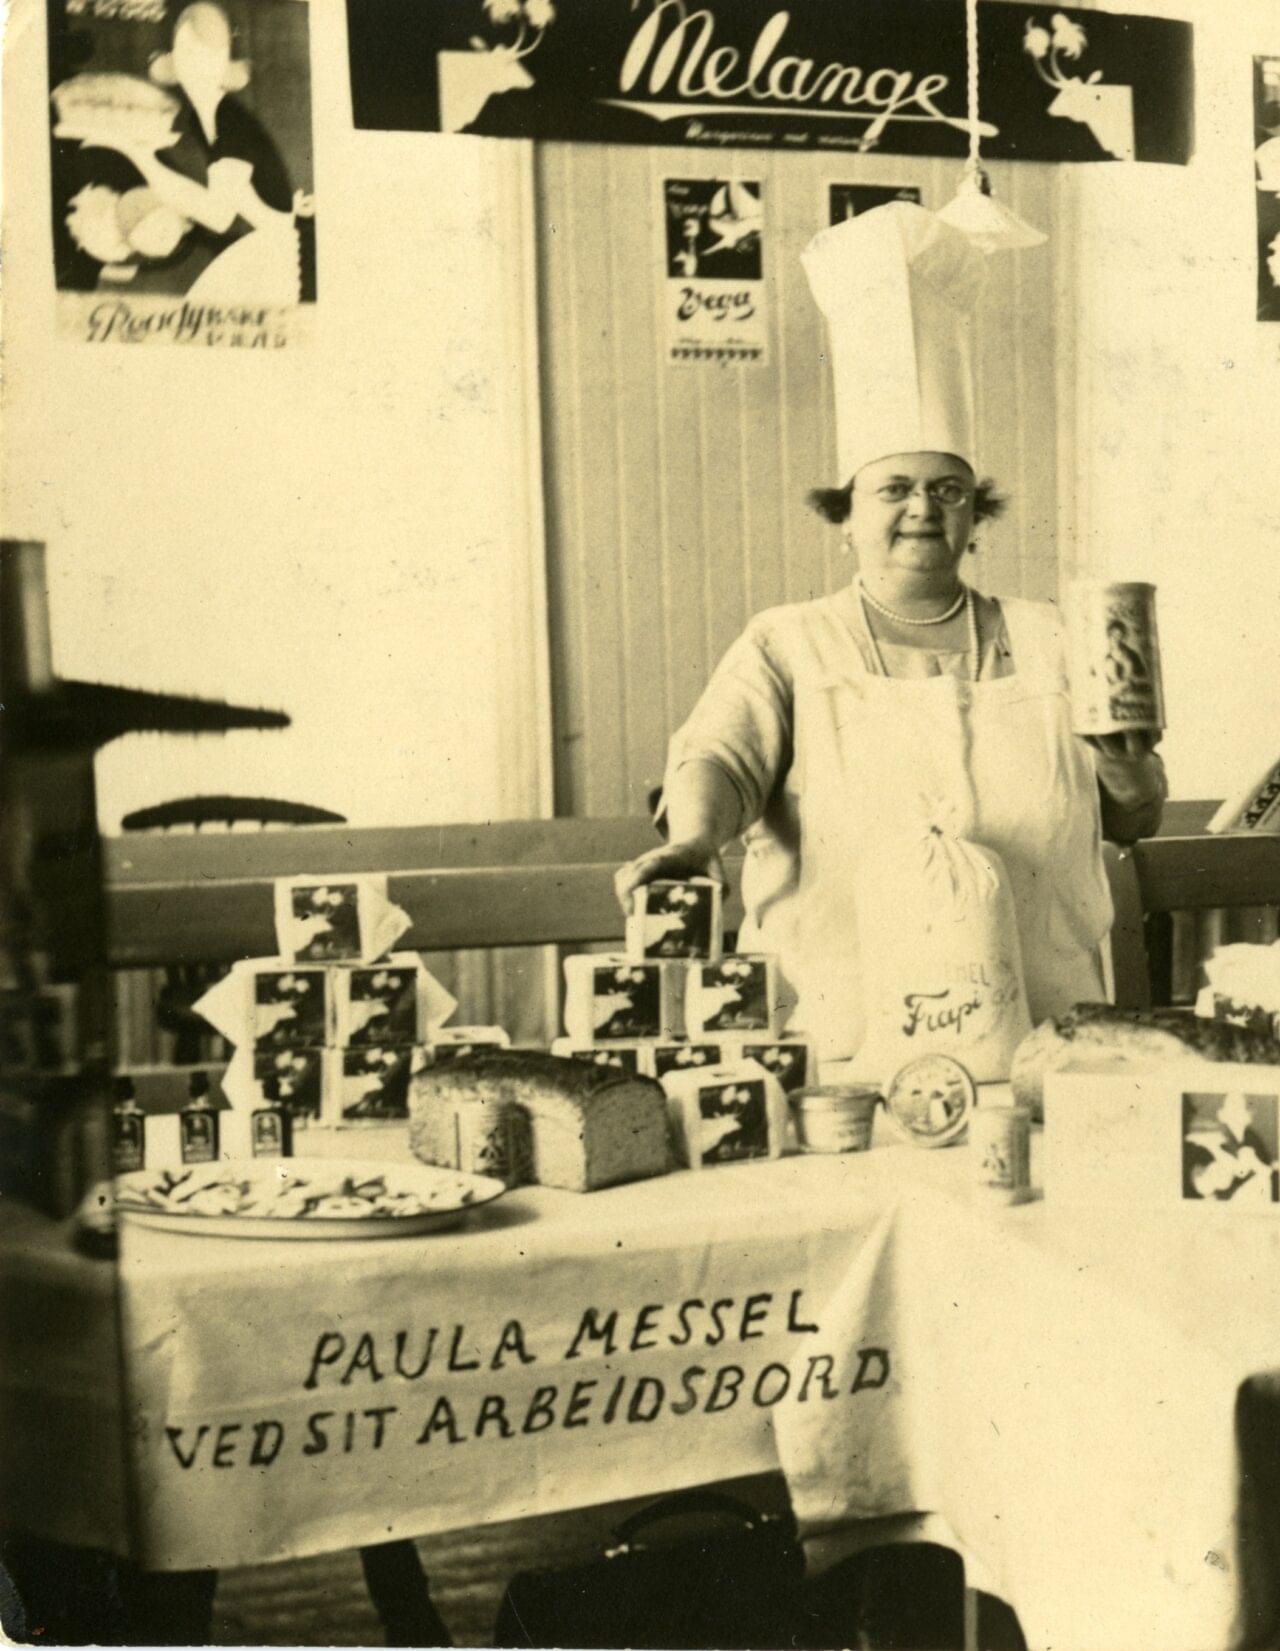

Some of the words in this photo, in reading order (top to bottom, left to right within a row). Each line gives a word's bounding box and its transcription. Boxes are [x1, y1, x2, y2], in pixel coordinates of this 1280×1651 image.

[619, 0, 958, 152] Melange
[902, 988, 982, 1037] Frapi
[303, 1320, 537, 1390] PAULA
[564, 1288, 820, 1361] MESSEL
[165, 1422, 285, 1471] VED
[301, 1406, 399, 1457] SIT
[416, 1346, 891, 1445] ARBEIDSBORD
